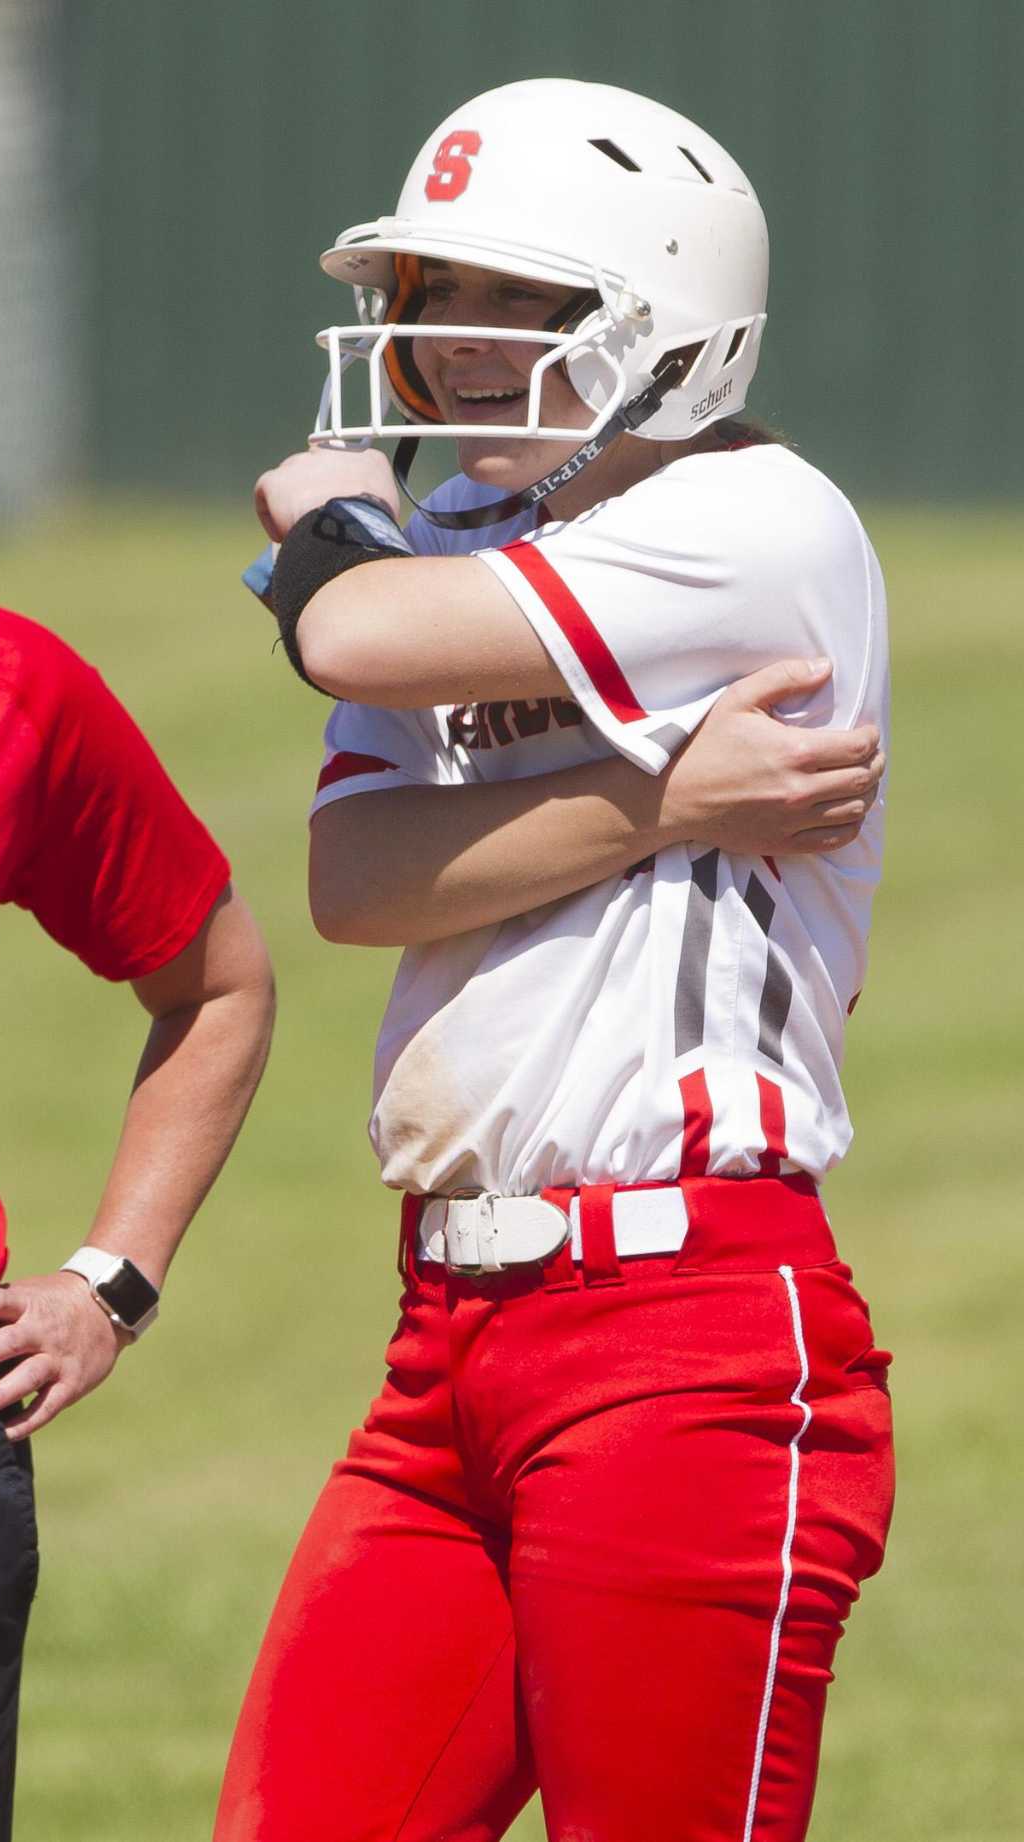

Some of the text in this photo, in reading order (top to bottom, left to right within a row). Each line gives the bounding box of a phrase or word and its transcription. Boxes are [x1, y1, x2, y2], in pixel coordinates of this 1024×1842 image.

[424, 130, 482, 203] S
[690, 378, 733, 420] schutt
[530, 440, 604, 502] RIP-IT
